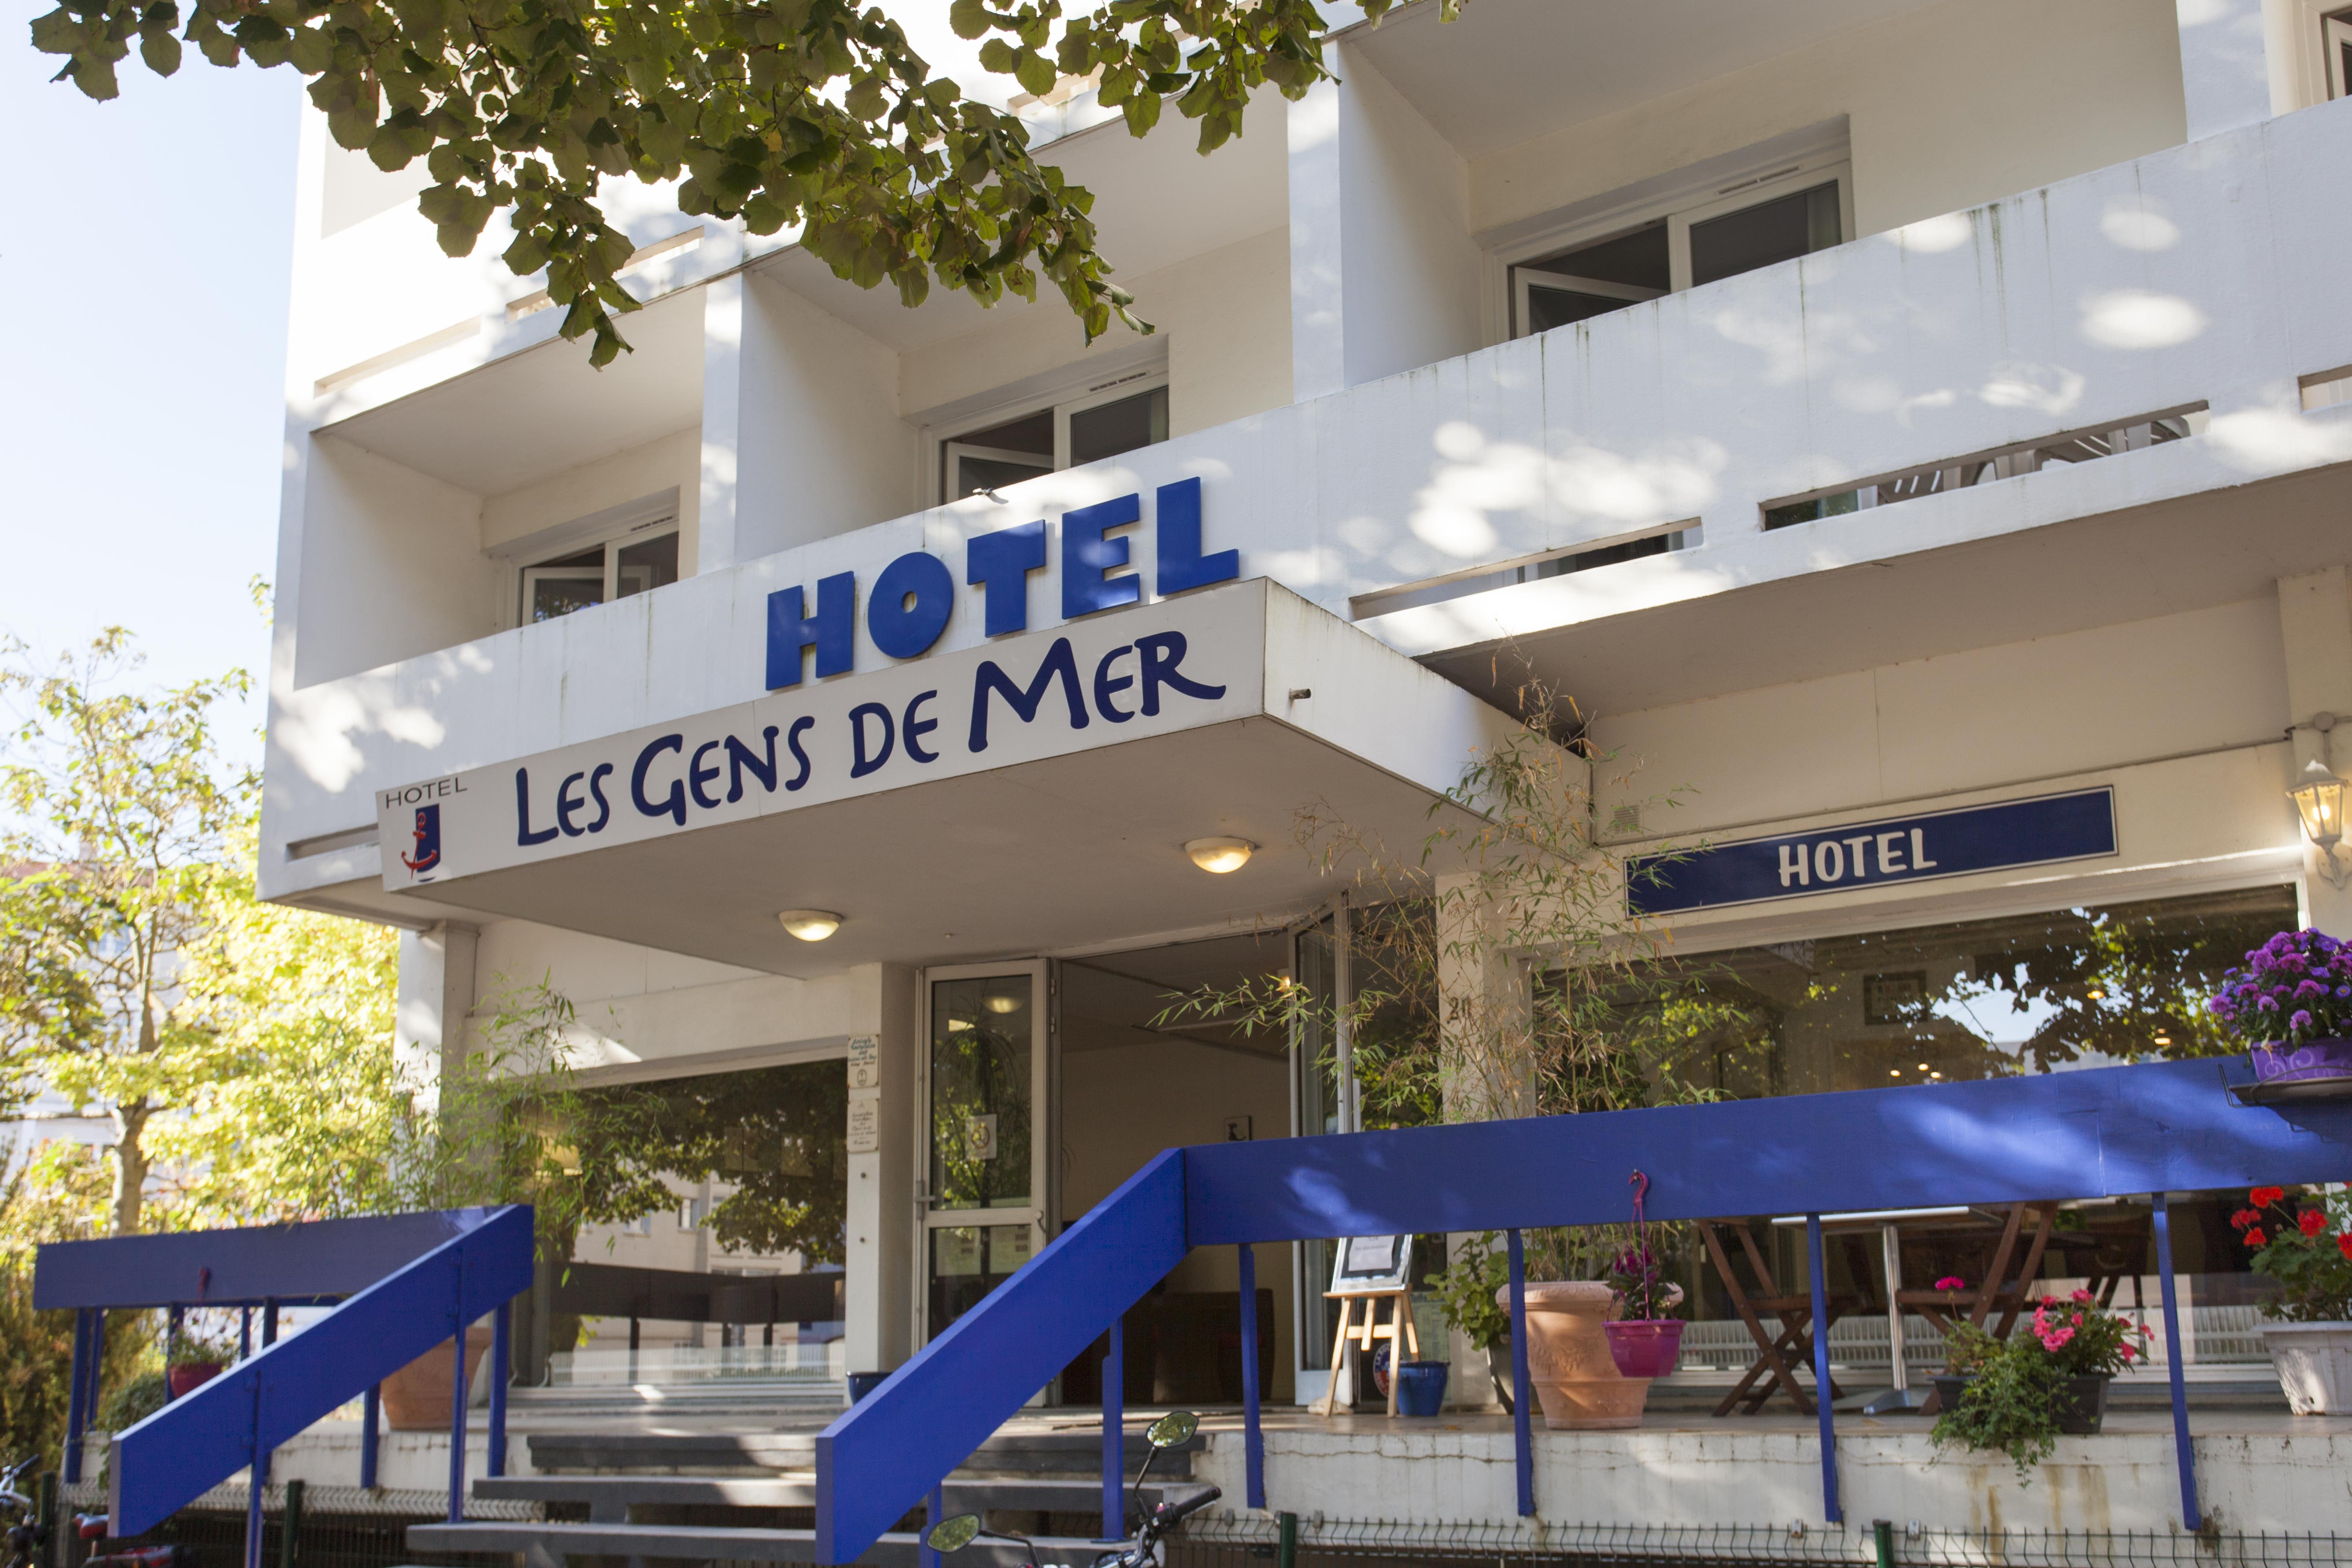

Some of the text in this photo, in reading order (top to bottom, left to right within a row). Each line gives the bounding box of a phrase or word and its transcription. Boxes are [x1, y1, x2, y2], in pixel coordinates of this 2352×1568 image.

[766, 477, 1239, 691] HOTEL
[385, 777, 468, 810] HOTEL
[516, 630, 1226, 846] LES GENS DE MER
[1778, 828, 1938, 887] HOTEL
